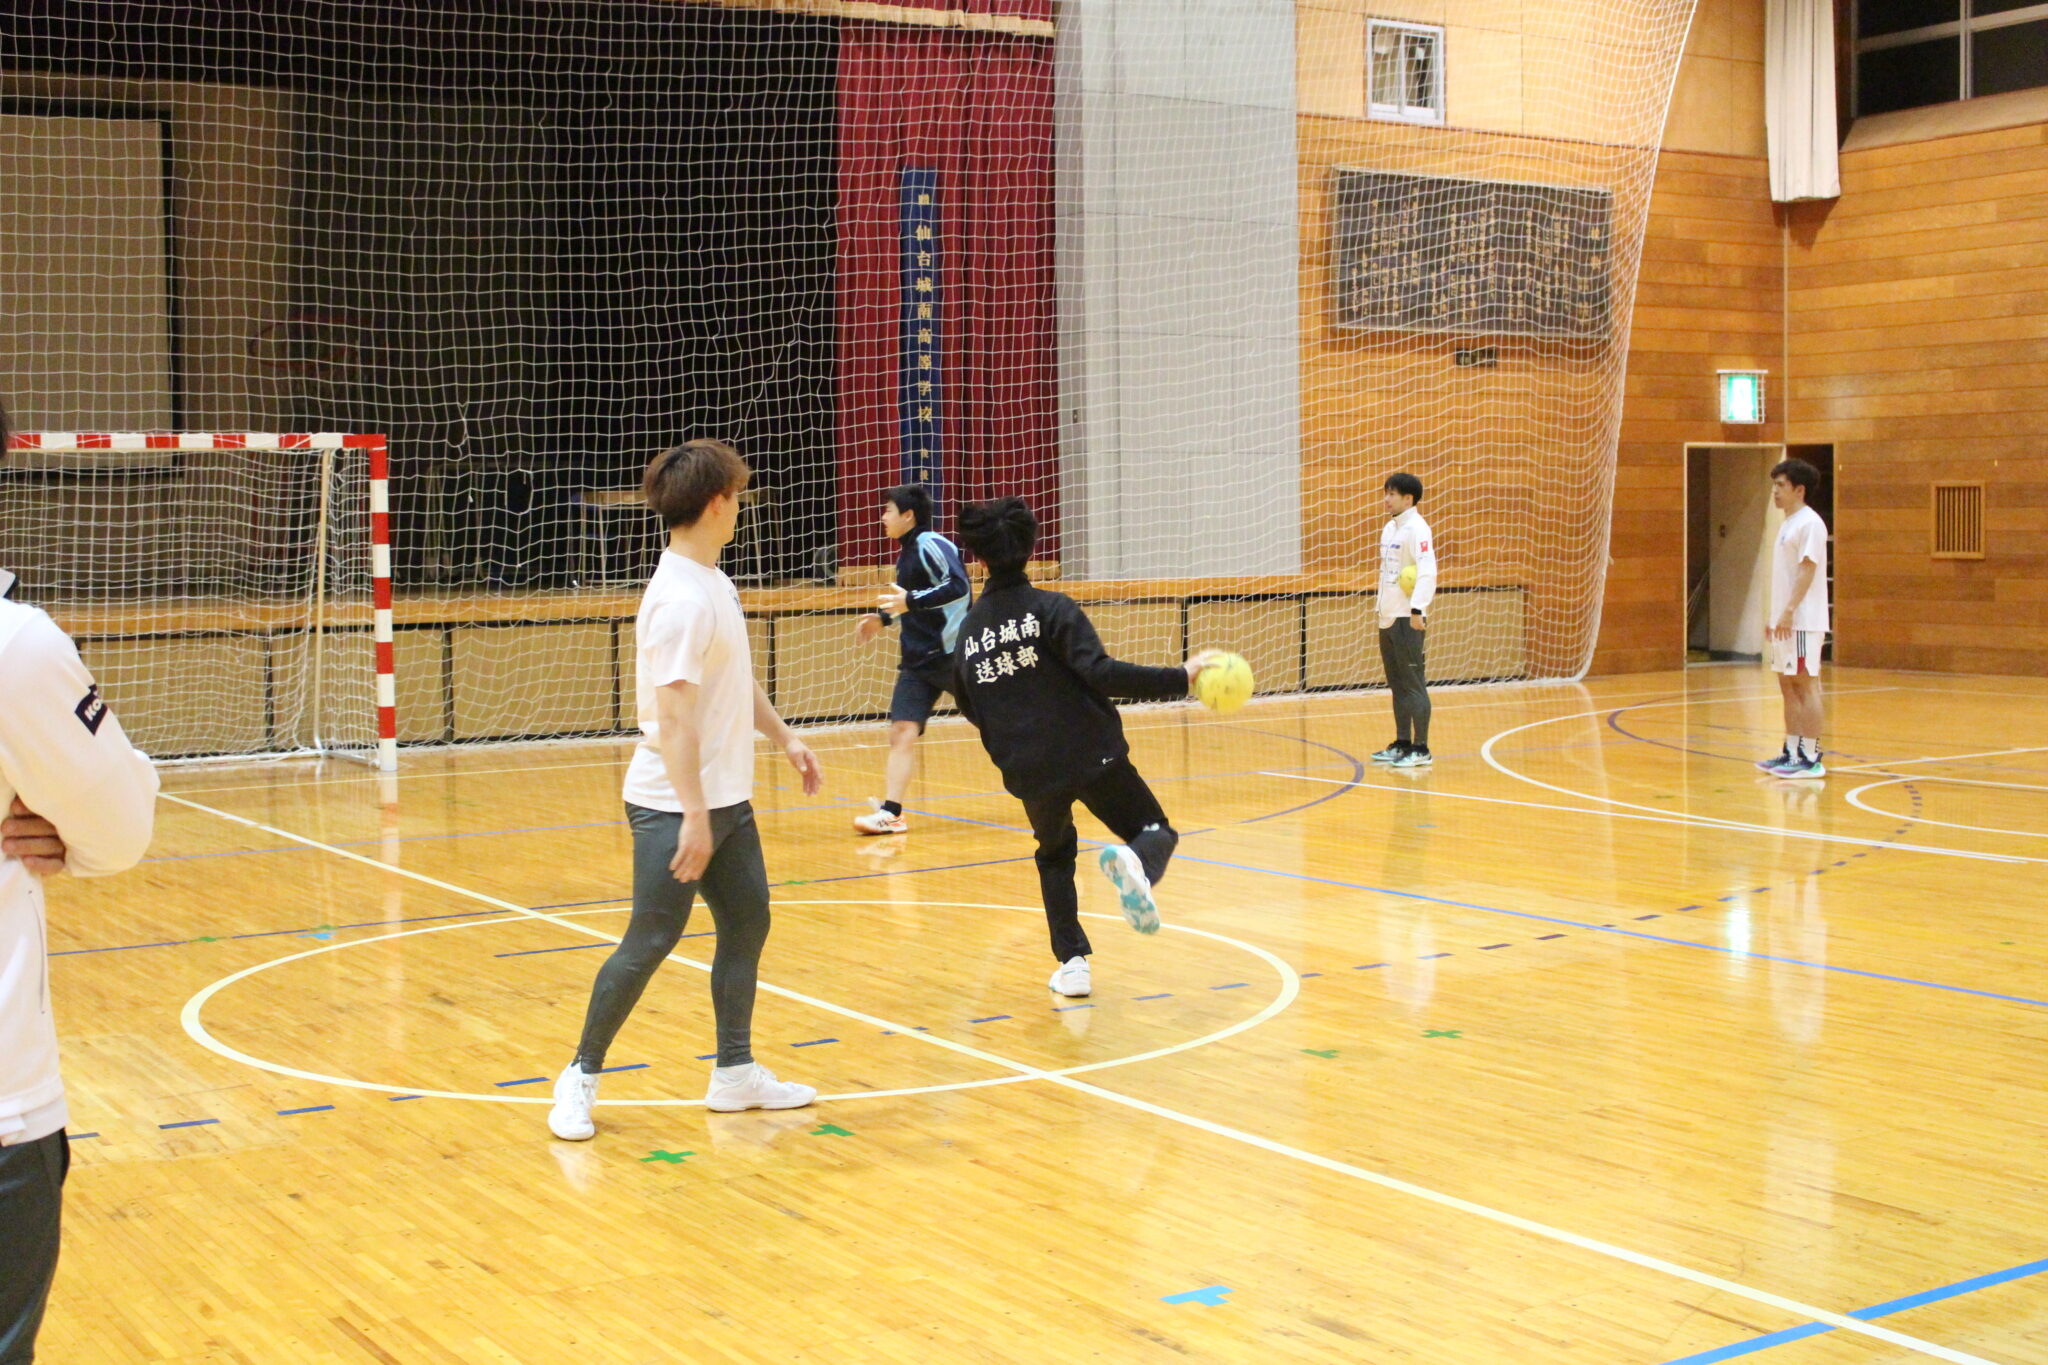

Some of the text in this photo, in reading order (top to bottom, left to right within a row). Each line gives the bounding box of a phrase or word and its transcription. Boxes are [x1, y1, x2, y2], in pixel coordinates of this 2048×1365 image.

[915, 225, 932, 422] 仙台城南高等学校
[965, 612, 1040, 660] 仙台城南
[975, 645, 1038, 684] 送球部
